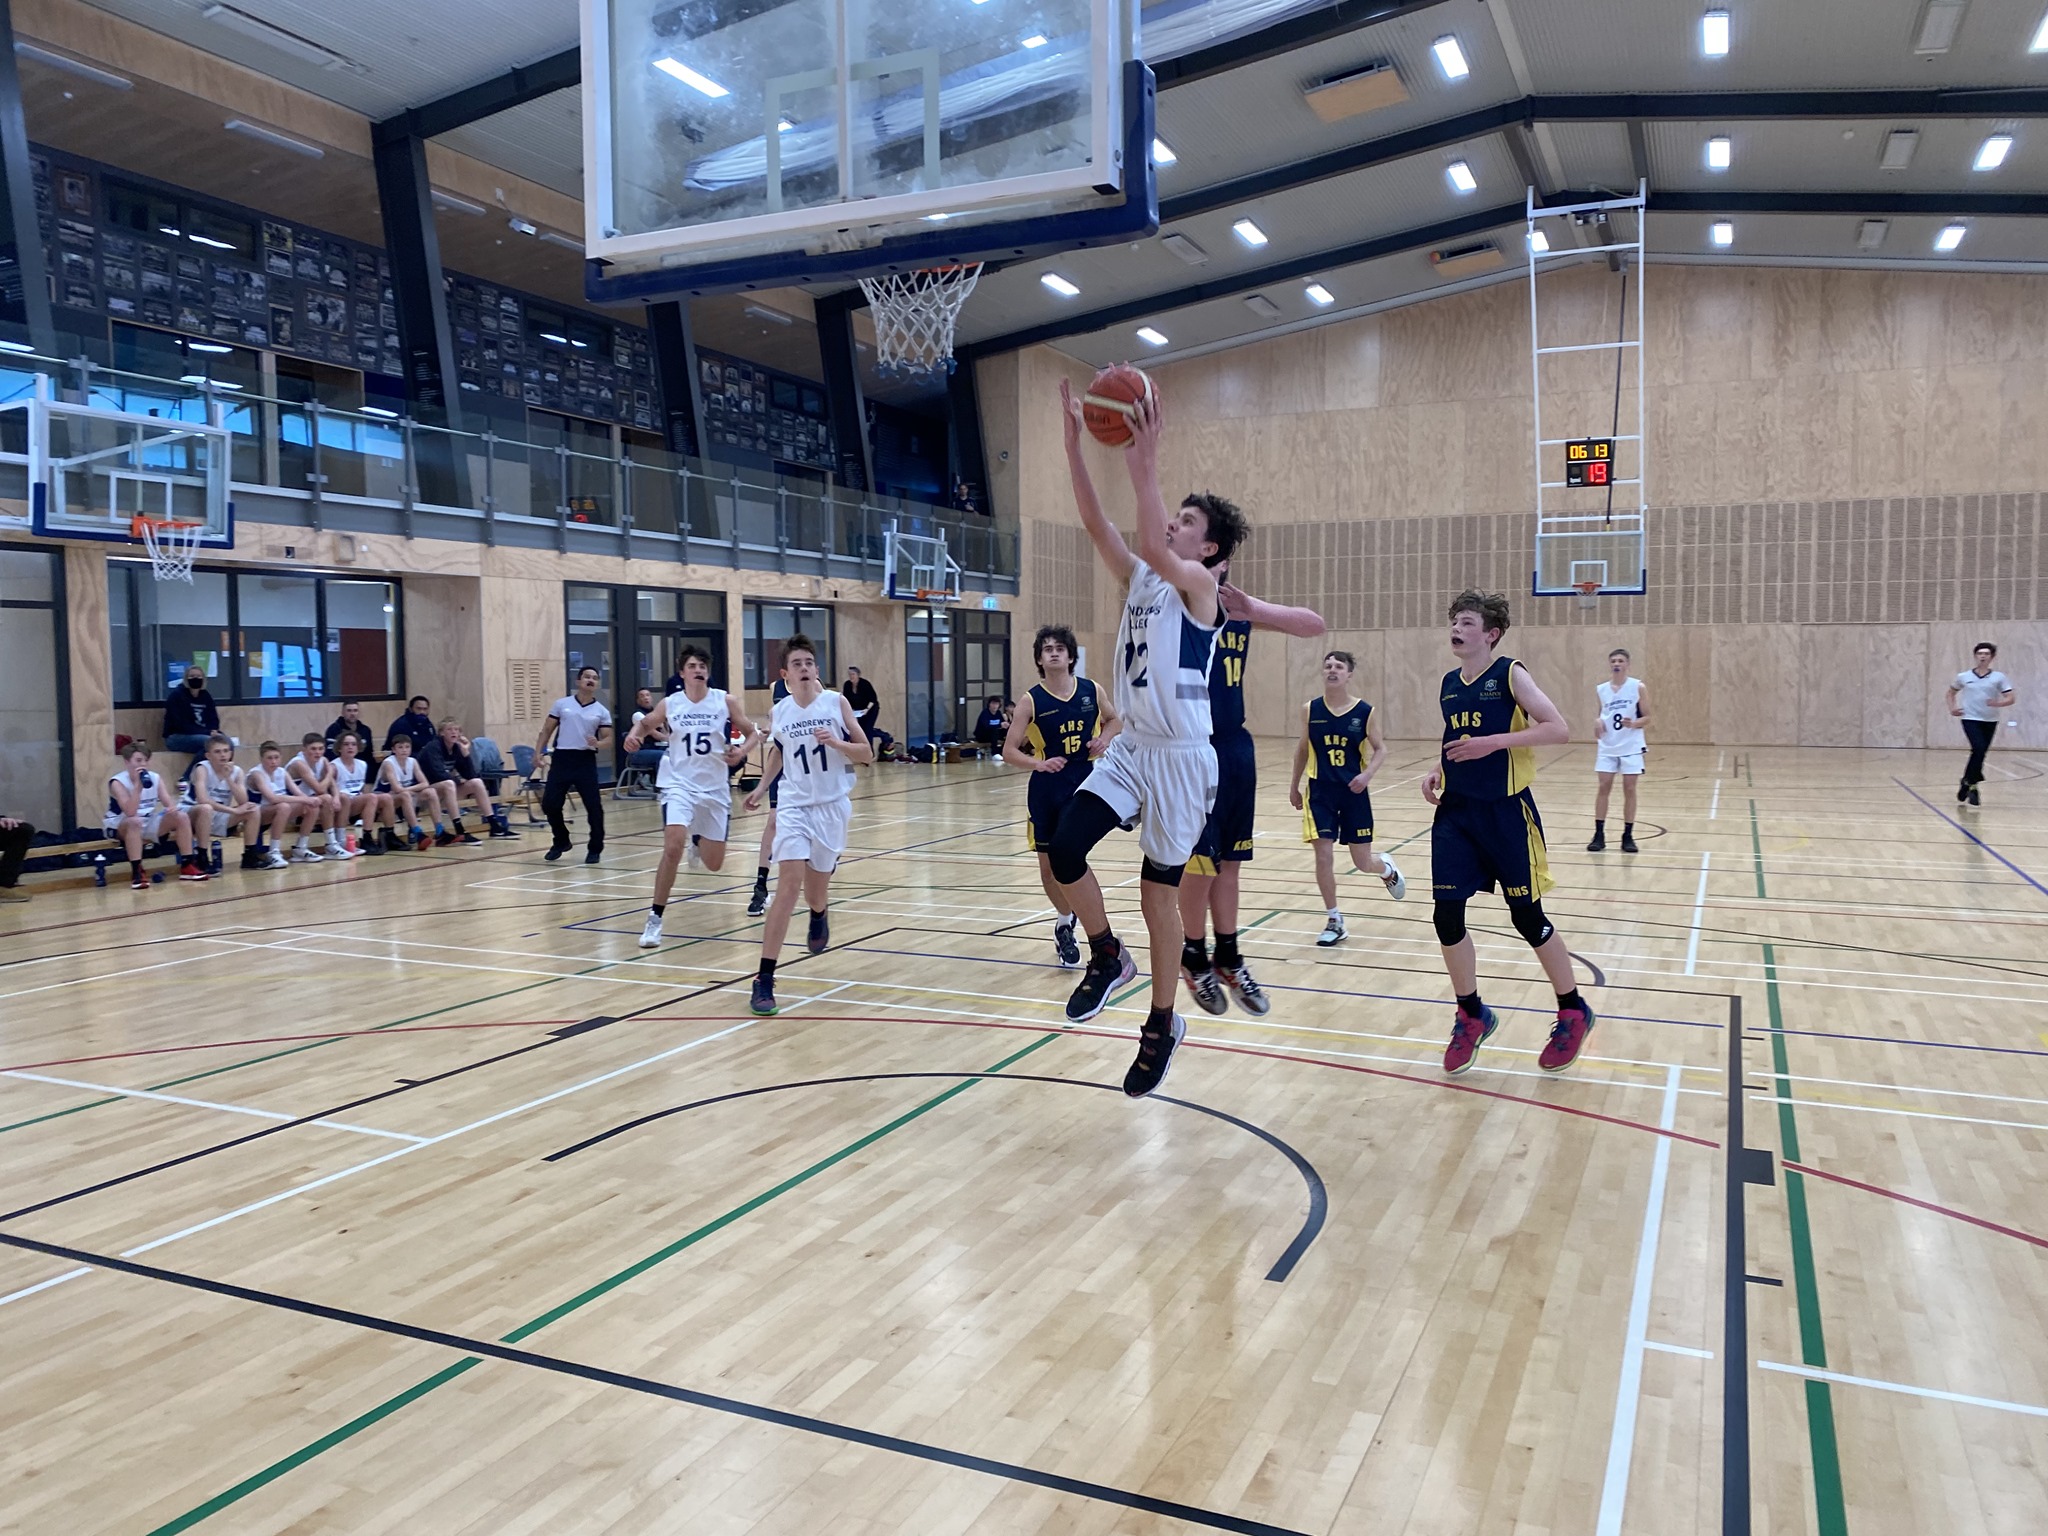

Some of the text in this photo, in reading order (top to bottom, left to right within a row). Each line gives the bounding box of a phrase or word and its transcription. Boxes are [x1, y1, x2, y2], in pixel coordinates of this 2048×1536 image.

[1570, 443, 1608, 459] 06 13
[1590, 463, 1607, 483] 19
[1224, 656, 1241, 687] 14
[781, 718, 832, 734] ST ANDREW'S
[1059, 720, 1084, 734] KHS
[1450, 711, 1482, 730] KHS
[1613, 713, 1623, 731] 8
[681, 732, 712, 757] 15
[1061, 735, 1082, 755] 15
[1323, 734, 1348, 747] KHS
[793, 743, 828, 775] 11
[1327, 749, 1346, 767] 13
[1506, 885, 1529, 898] KHS
